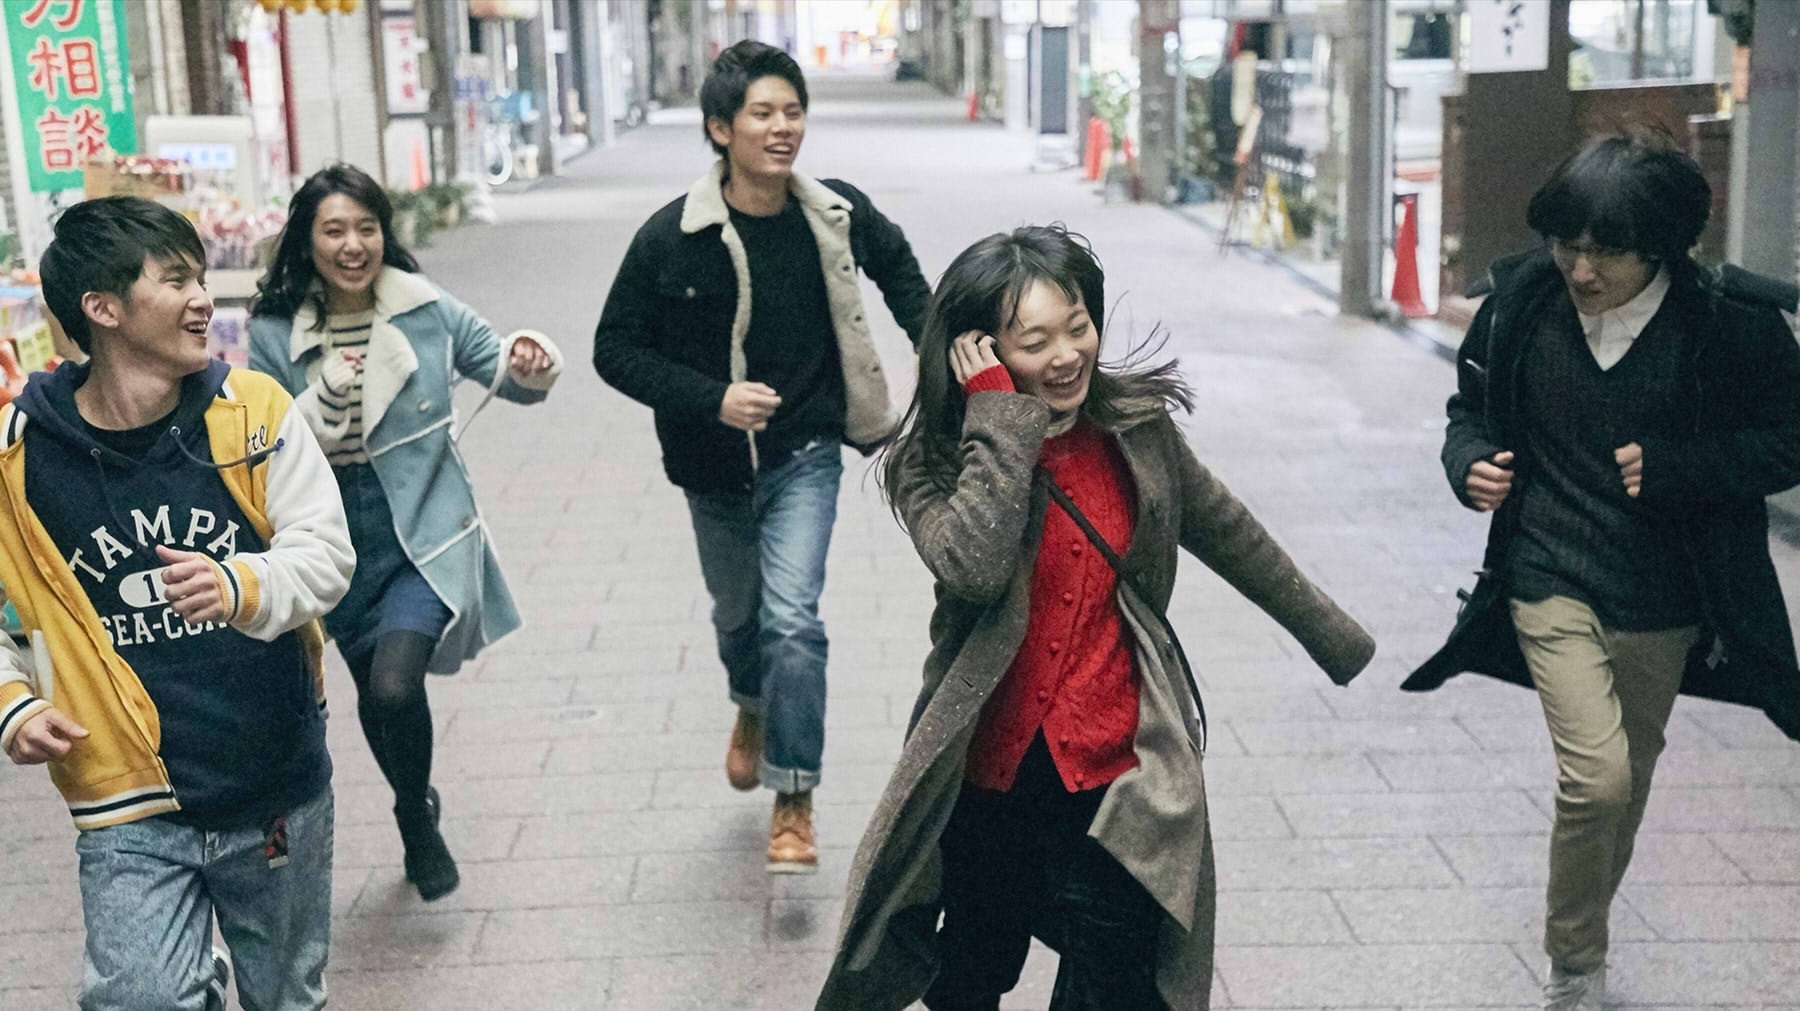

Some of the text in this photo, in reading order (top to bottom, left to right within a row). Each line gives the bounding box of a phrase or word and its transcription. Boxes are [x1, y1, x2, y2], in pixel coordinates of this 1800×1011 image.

[69, 505, 240, 583] TAMPA
[143, 573, 160, 603] 1
[99, 608, 228, 646] SEA-C
